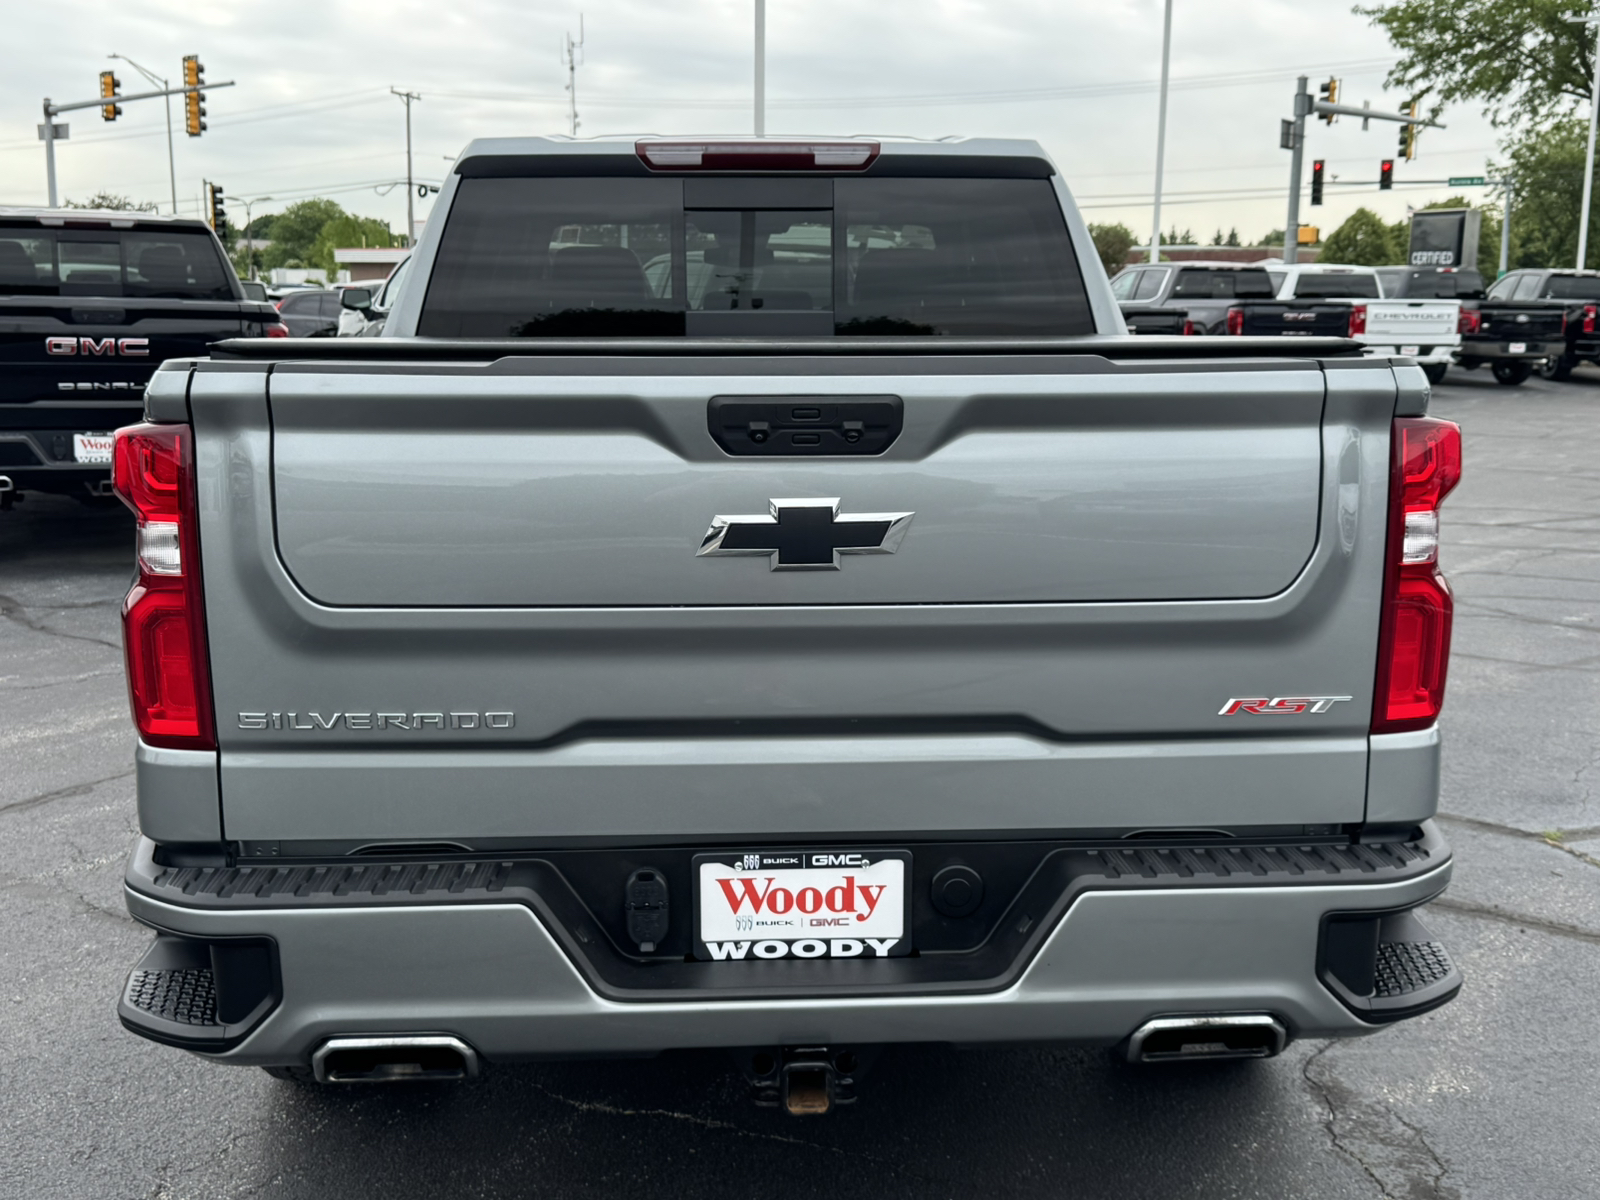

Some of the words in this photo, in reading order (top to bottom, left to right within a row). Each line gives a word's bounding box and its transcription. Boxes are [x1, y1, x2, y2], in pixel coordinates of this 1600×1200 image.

[1411, 251, 1454, 265] CERTIFIED
[1374, 312, 1453, 320] CHEVROLET
[45, 336, 150, 356] GMC
[80, 438, 113, 450] Woo
[78, 455, 112, 463] WOO
[1218, 695, 1353, 716] RST
[238, 711, 516, 730] SILVERADO
[811, 854, 863, 866] GMC
[715, 876, 888, 922] Woody
[810, 917, 850, 927] GMC
[705, 938, 900, 961] WOODY
